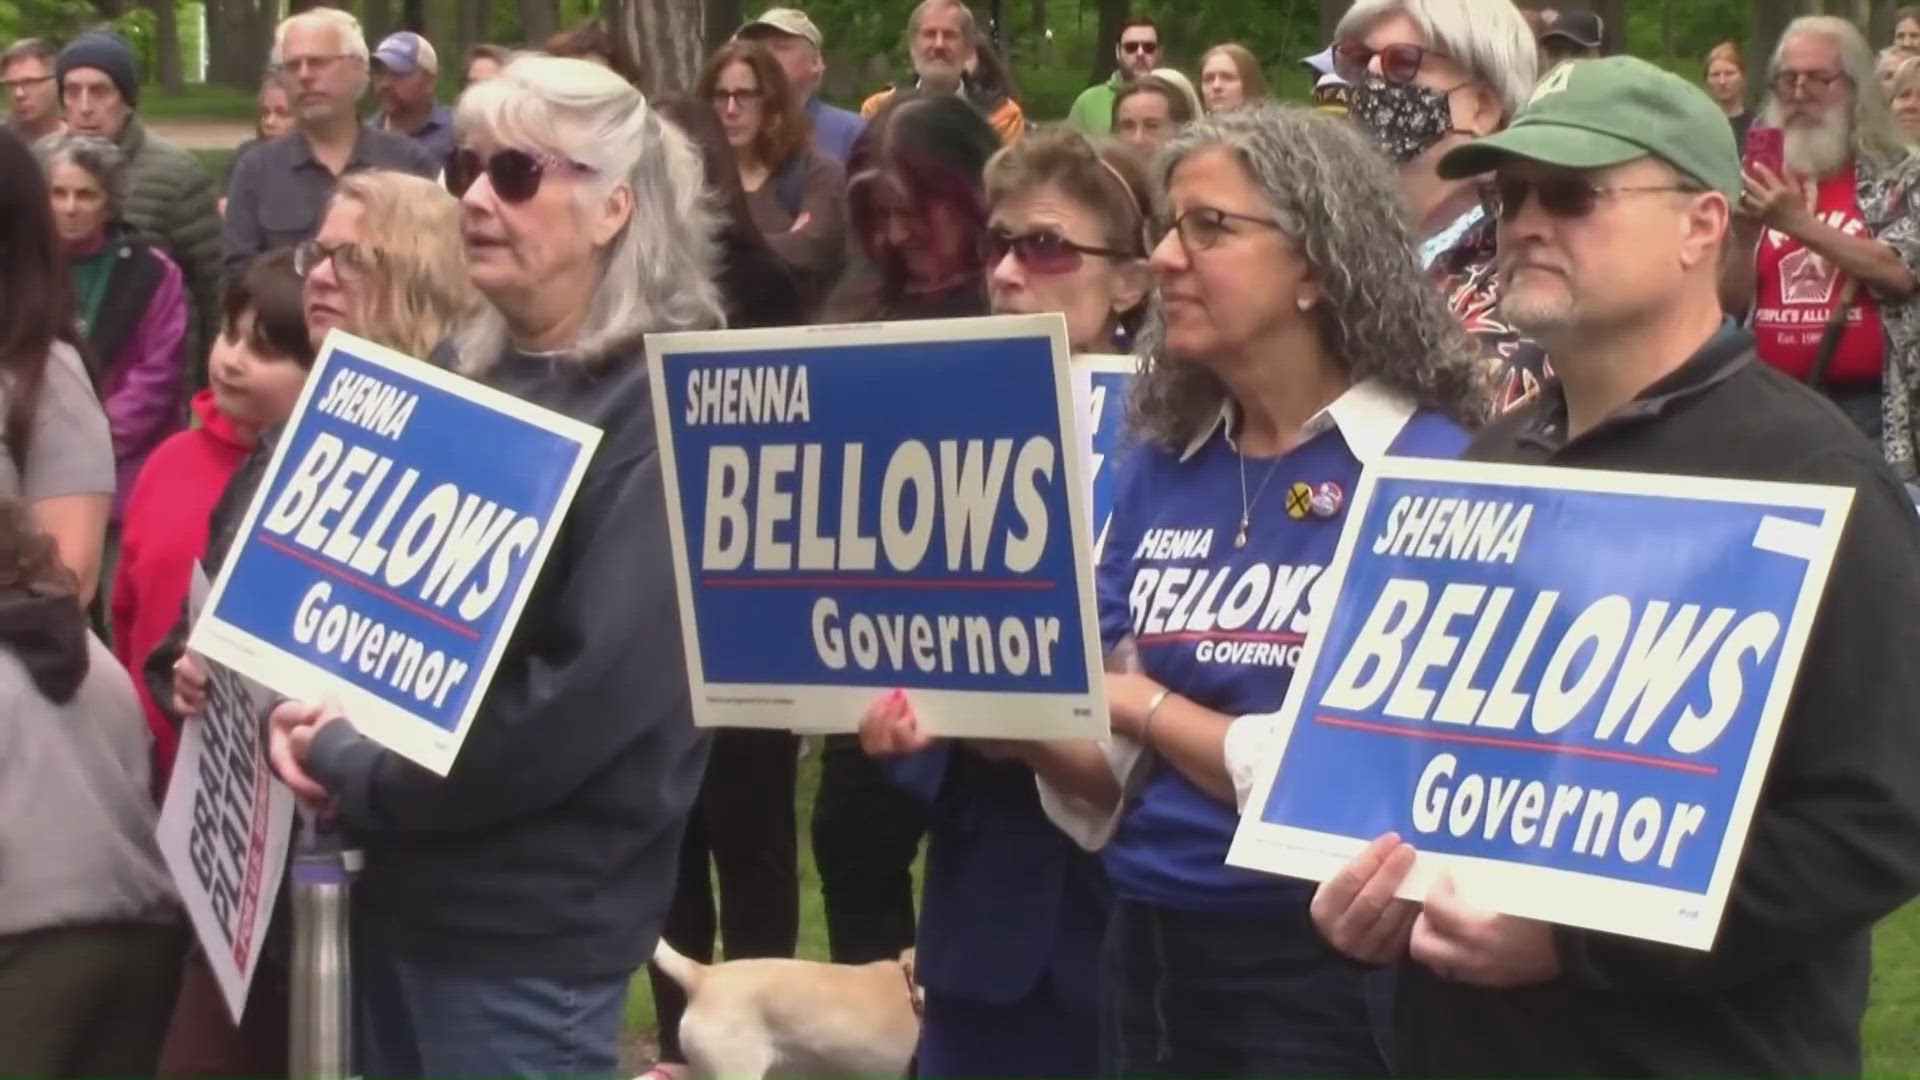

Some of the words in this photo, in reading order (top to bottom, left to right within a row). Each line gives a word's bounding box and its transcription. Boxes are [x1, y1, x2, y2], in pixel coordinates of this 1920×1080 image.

[1802, 307, 1863, 323] ALLICE
[318, 368, 419, 441] SHENNA
[685, 364, 810, 426] SHENNA
[263, 432, 539, 621] BELLOWS
[702, 435, 1055, 573] BELLOWS
[1372, 495, 1533, 564] SHENNA
[293, 581, 468, 708] Governor
[812, 597, 1060, 676] Governor
[1195, 640, 1302, 668] GOVERNO
[1318, 577, 1781, 754] BELLOWS
[211, 672, 257, 950] PLATNER
[1412, 752, 1706, 869] Governor
